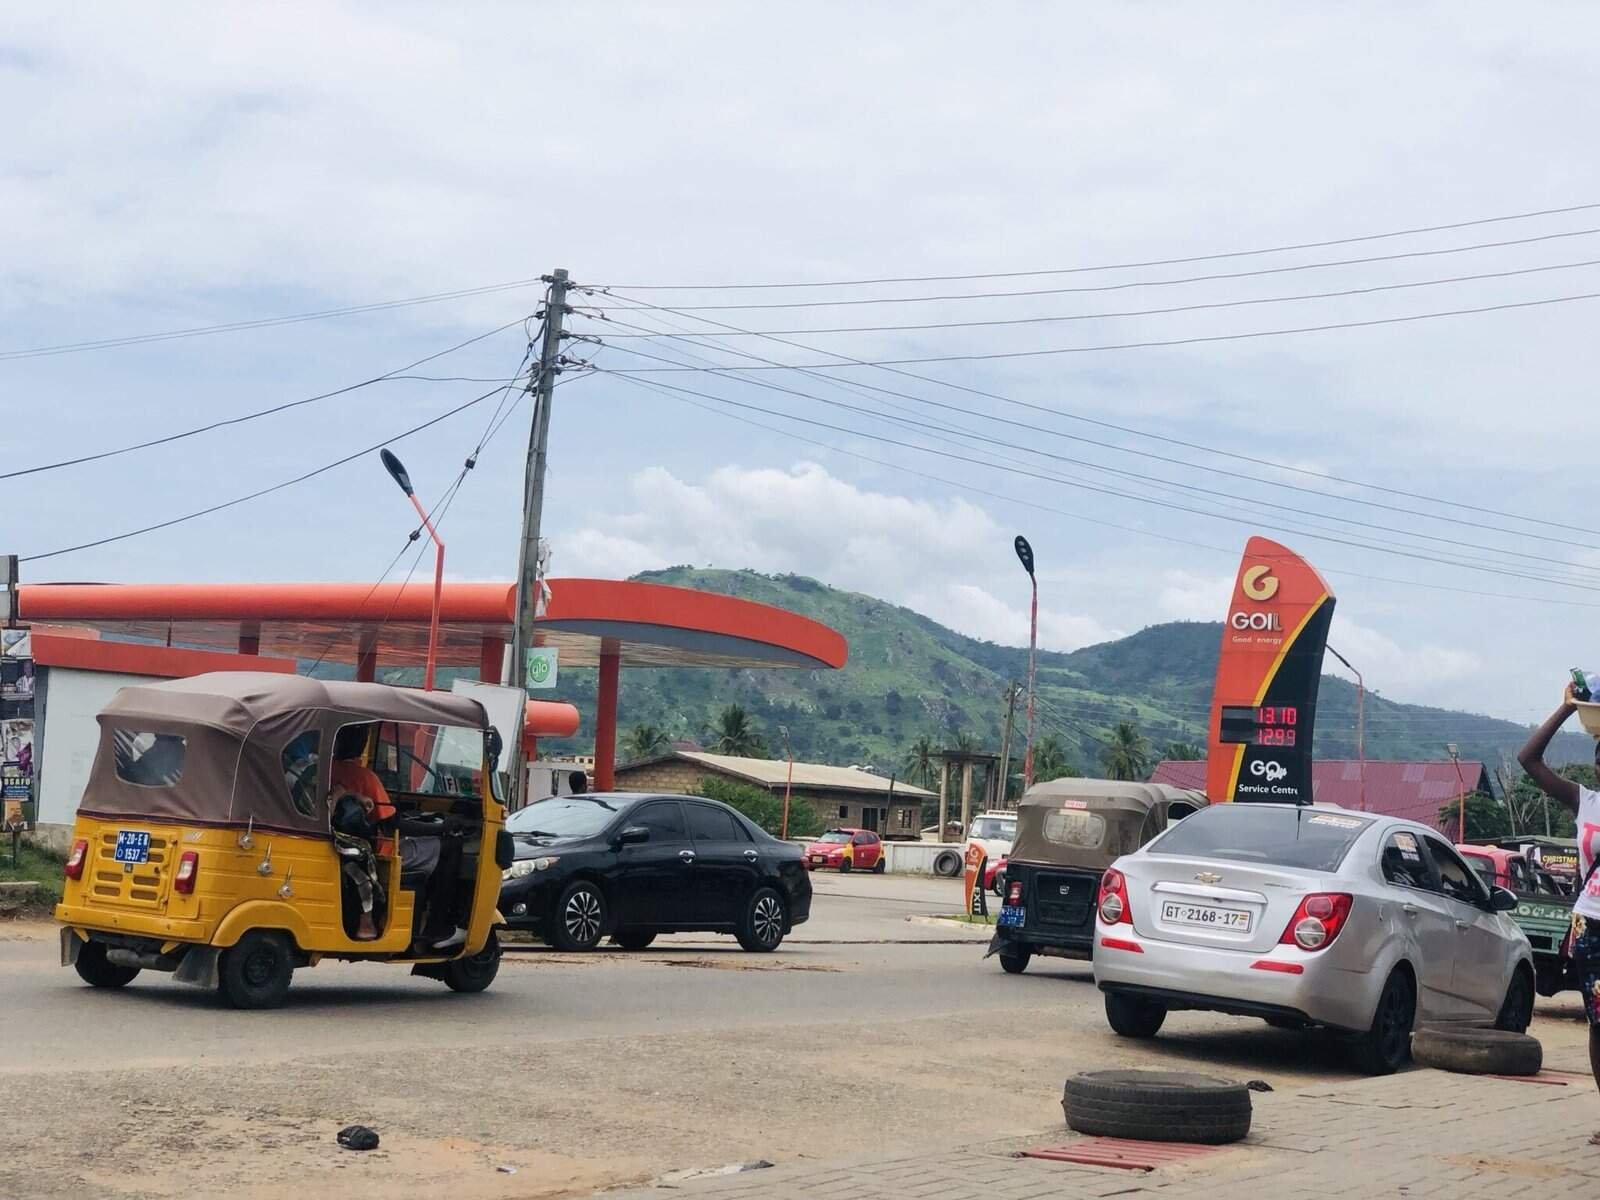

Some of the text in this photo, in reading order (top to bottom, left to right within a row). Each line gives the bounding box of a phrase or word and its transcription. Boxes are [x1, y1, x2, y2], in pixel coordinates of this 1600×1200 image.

[1231, 611, 1282, 631] GOIL
[1232, 635, 1282, 645] Good energy
[1238, 784, 1298, 795] Service Centre
[125, 848, 141, 860] 1537
[974, 887, 982, 913] EXIT
